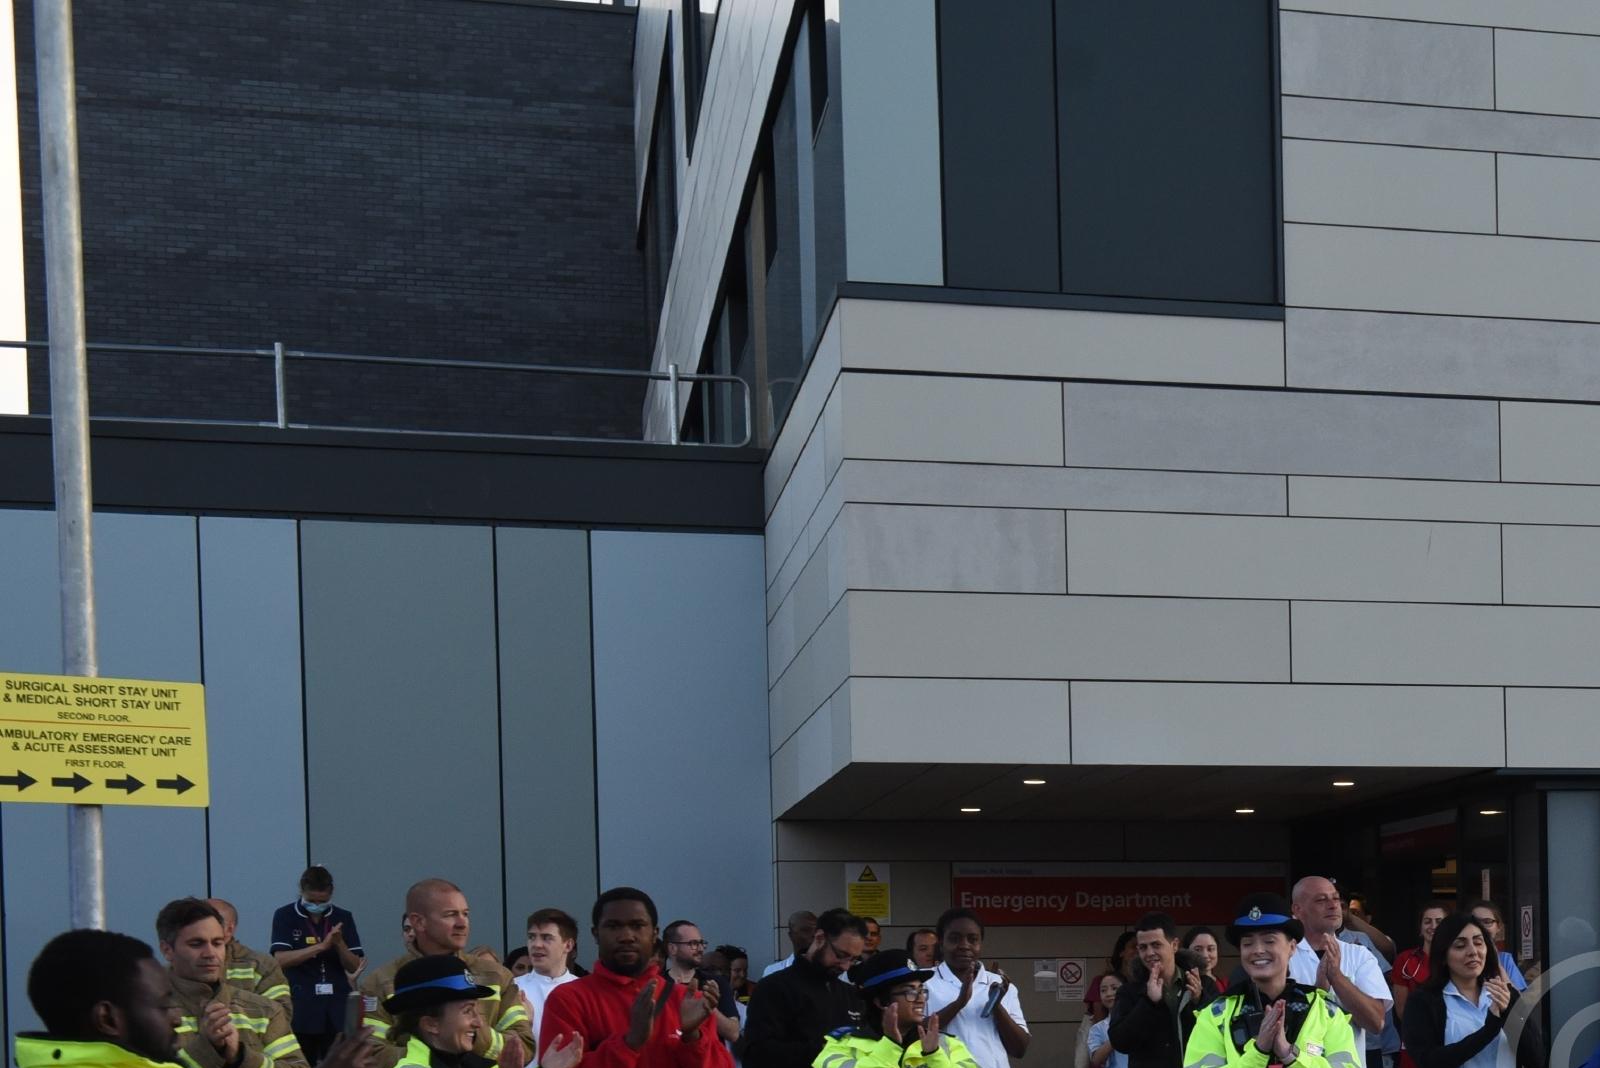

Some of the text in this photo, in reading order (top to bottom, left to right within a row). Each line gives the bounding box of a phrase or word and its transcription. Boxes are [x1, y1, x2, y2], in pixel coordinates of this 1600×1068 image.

[5, 679, 179, 699] SURGICAL SHORT STAY UNIT
[3, 693, 182, 712] & MEDICAL SHORT STAY UNIT
[57, 711, 95, 721] SECOND
[83, 732, 156, 745] EMERGENCY
[159, 735, 192, 746] CARE
[11, 741, 177, 757] & ACUTE ASSESSMENT UNIT
[65, 759, 91, 768] FIRST
[961, 890, 1193, 913] Emergency Department
